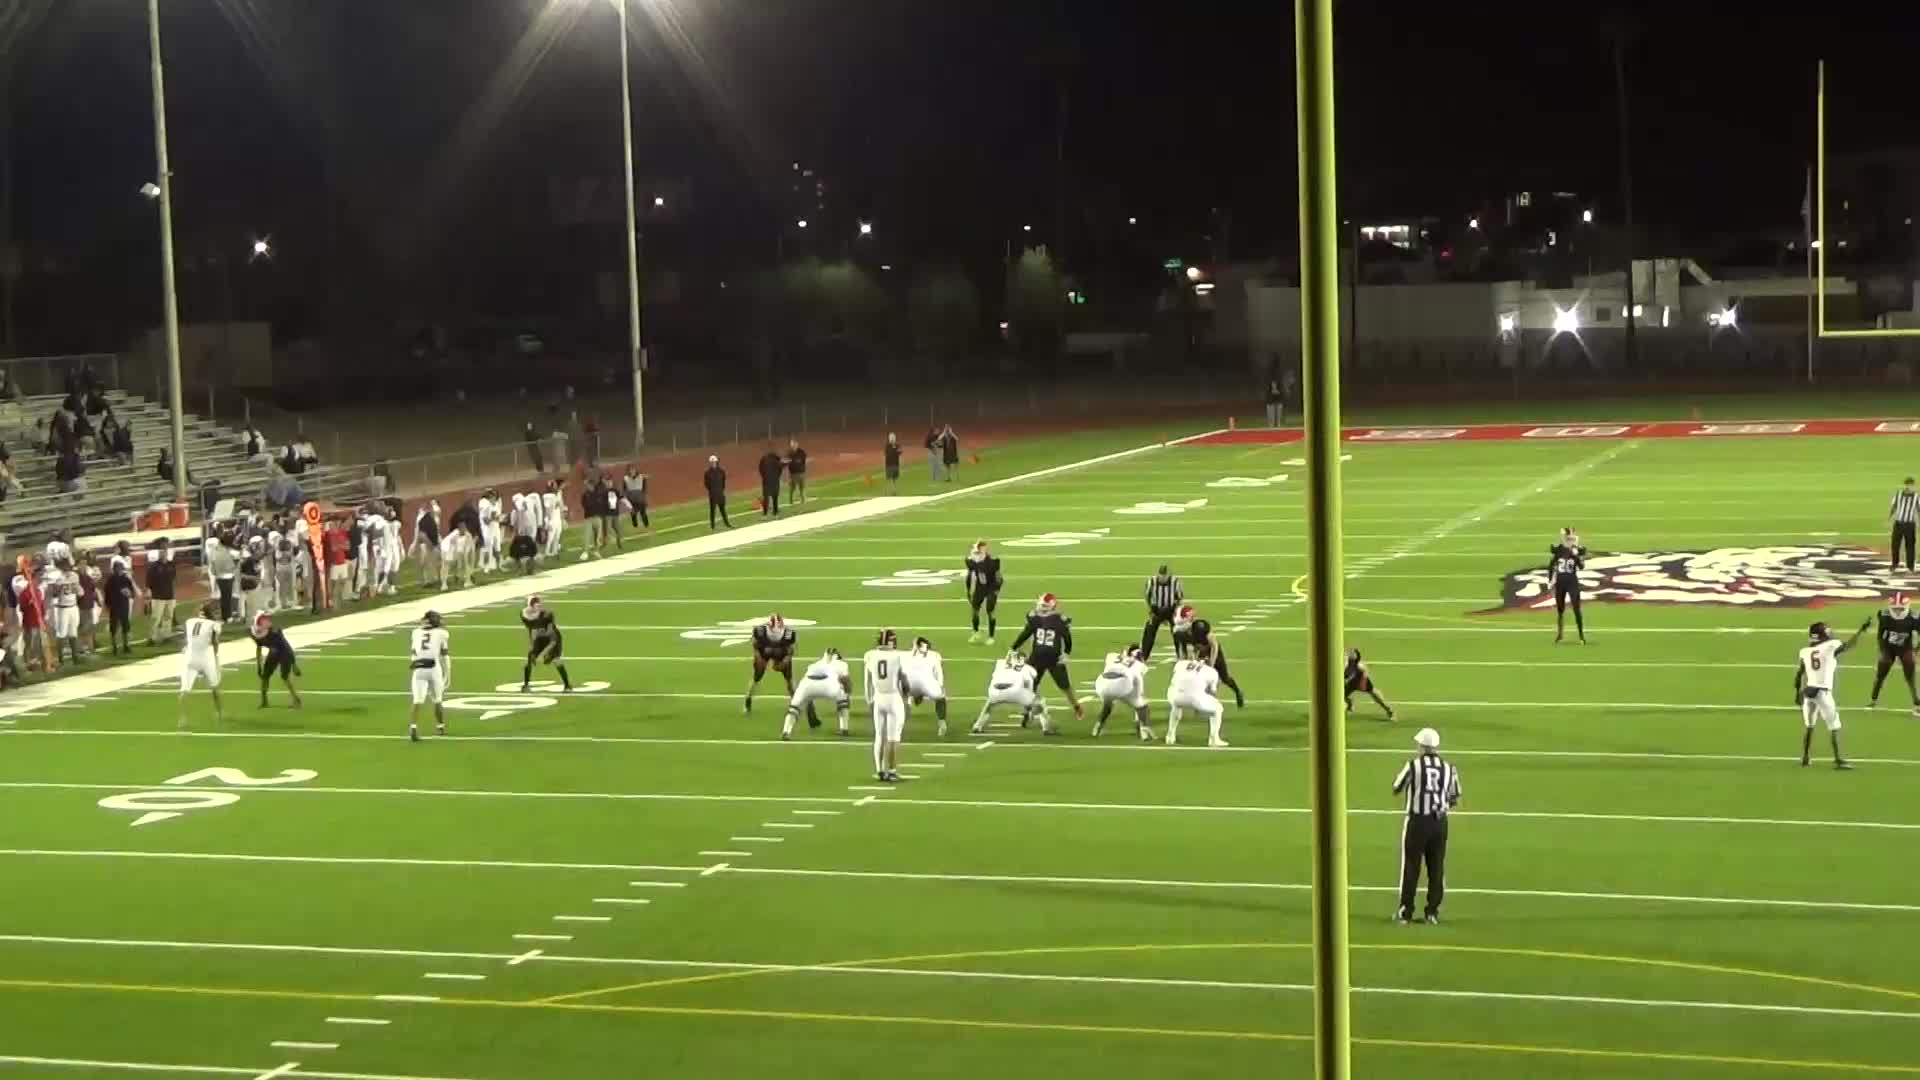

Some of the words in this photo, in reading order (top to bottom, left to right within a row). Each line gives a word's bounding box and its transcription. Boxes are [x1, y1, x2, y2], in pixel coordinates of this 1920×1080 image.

[421, 633, 431, 650] 2
[1036, 628, 1056, 647] 92
[877, 660, 888, 680] 0
[1810, 650, 1821, 671] 6
[440, 680, 612, 710] 30
[97, 766, 318, 810] 20
[1426, 768, 1440, 792] R
